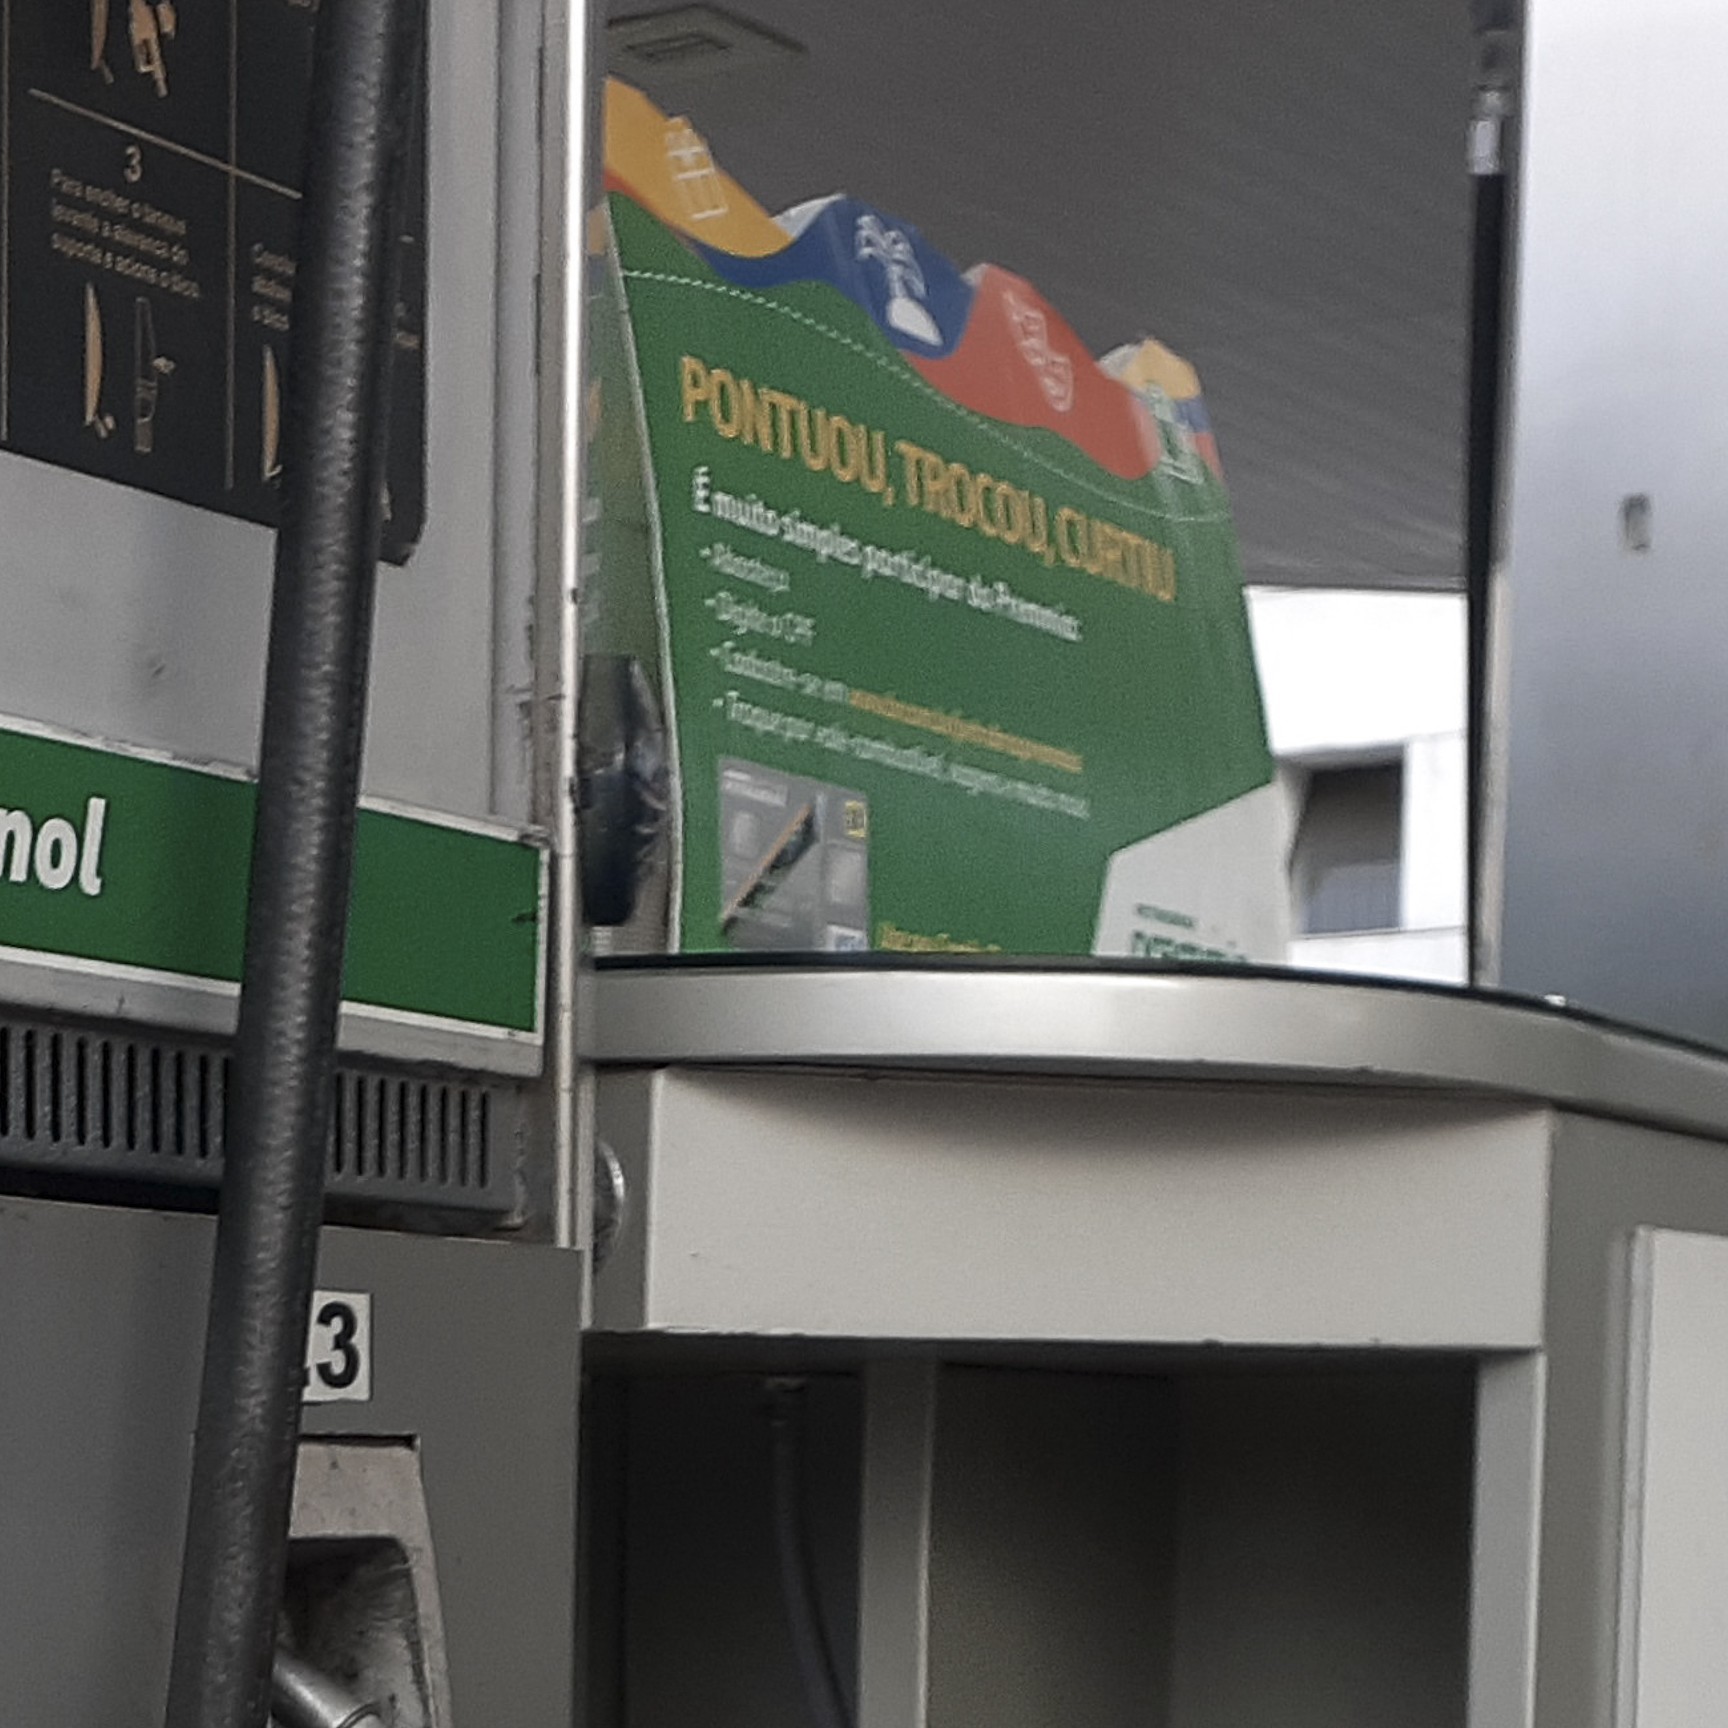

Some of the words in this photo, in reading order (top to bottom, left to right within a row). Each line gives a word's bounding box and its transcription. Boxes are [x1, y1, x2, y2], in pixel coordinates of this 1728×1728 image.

[124, 145, 143, 184] 3
[681, 354, 895, 507] PONTUOU,
[895, 439, 1056, 567] TROCOU,
[304, 1301, 361, 1390] 3
